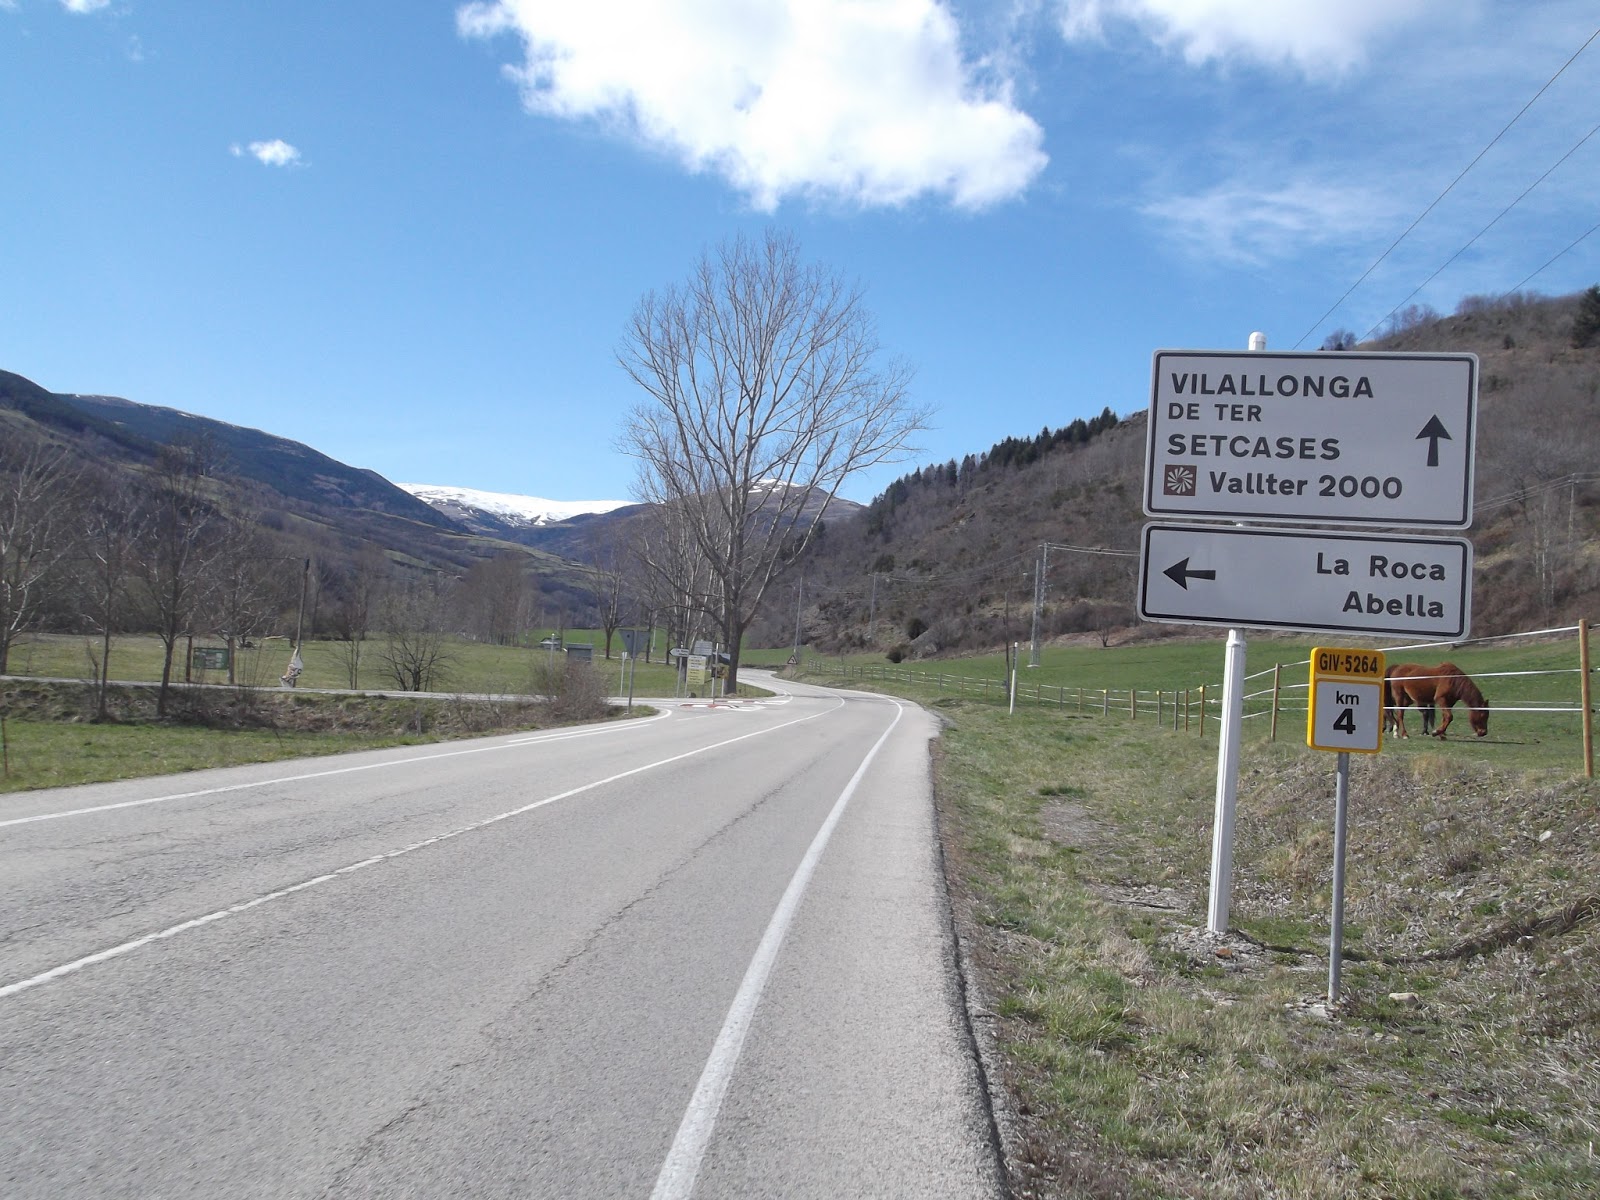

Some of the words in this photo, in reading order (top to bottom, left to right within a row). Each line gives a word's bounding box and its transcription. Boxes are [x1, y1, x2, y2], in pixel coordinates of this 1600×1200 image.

[1172, 372, 1374, 399] VILALLONGA
[1169, 403, 1200, 421] DE
[1215, 404, 1262, 422] TER
[1167, 434, 1341, 461] SETCASES
[1209, 472, 1308, 497] Vallter
[1318, 475, 1403, 500] 2000
[1316, 552, 1350, 576] La
[1369, 555, 1446, 581] Roca
[1342, 591, 1444, 619] Abella
[1335, 691, 1360, 706] km
[1332, 708, 1356, 735] 4
